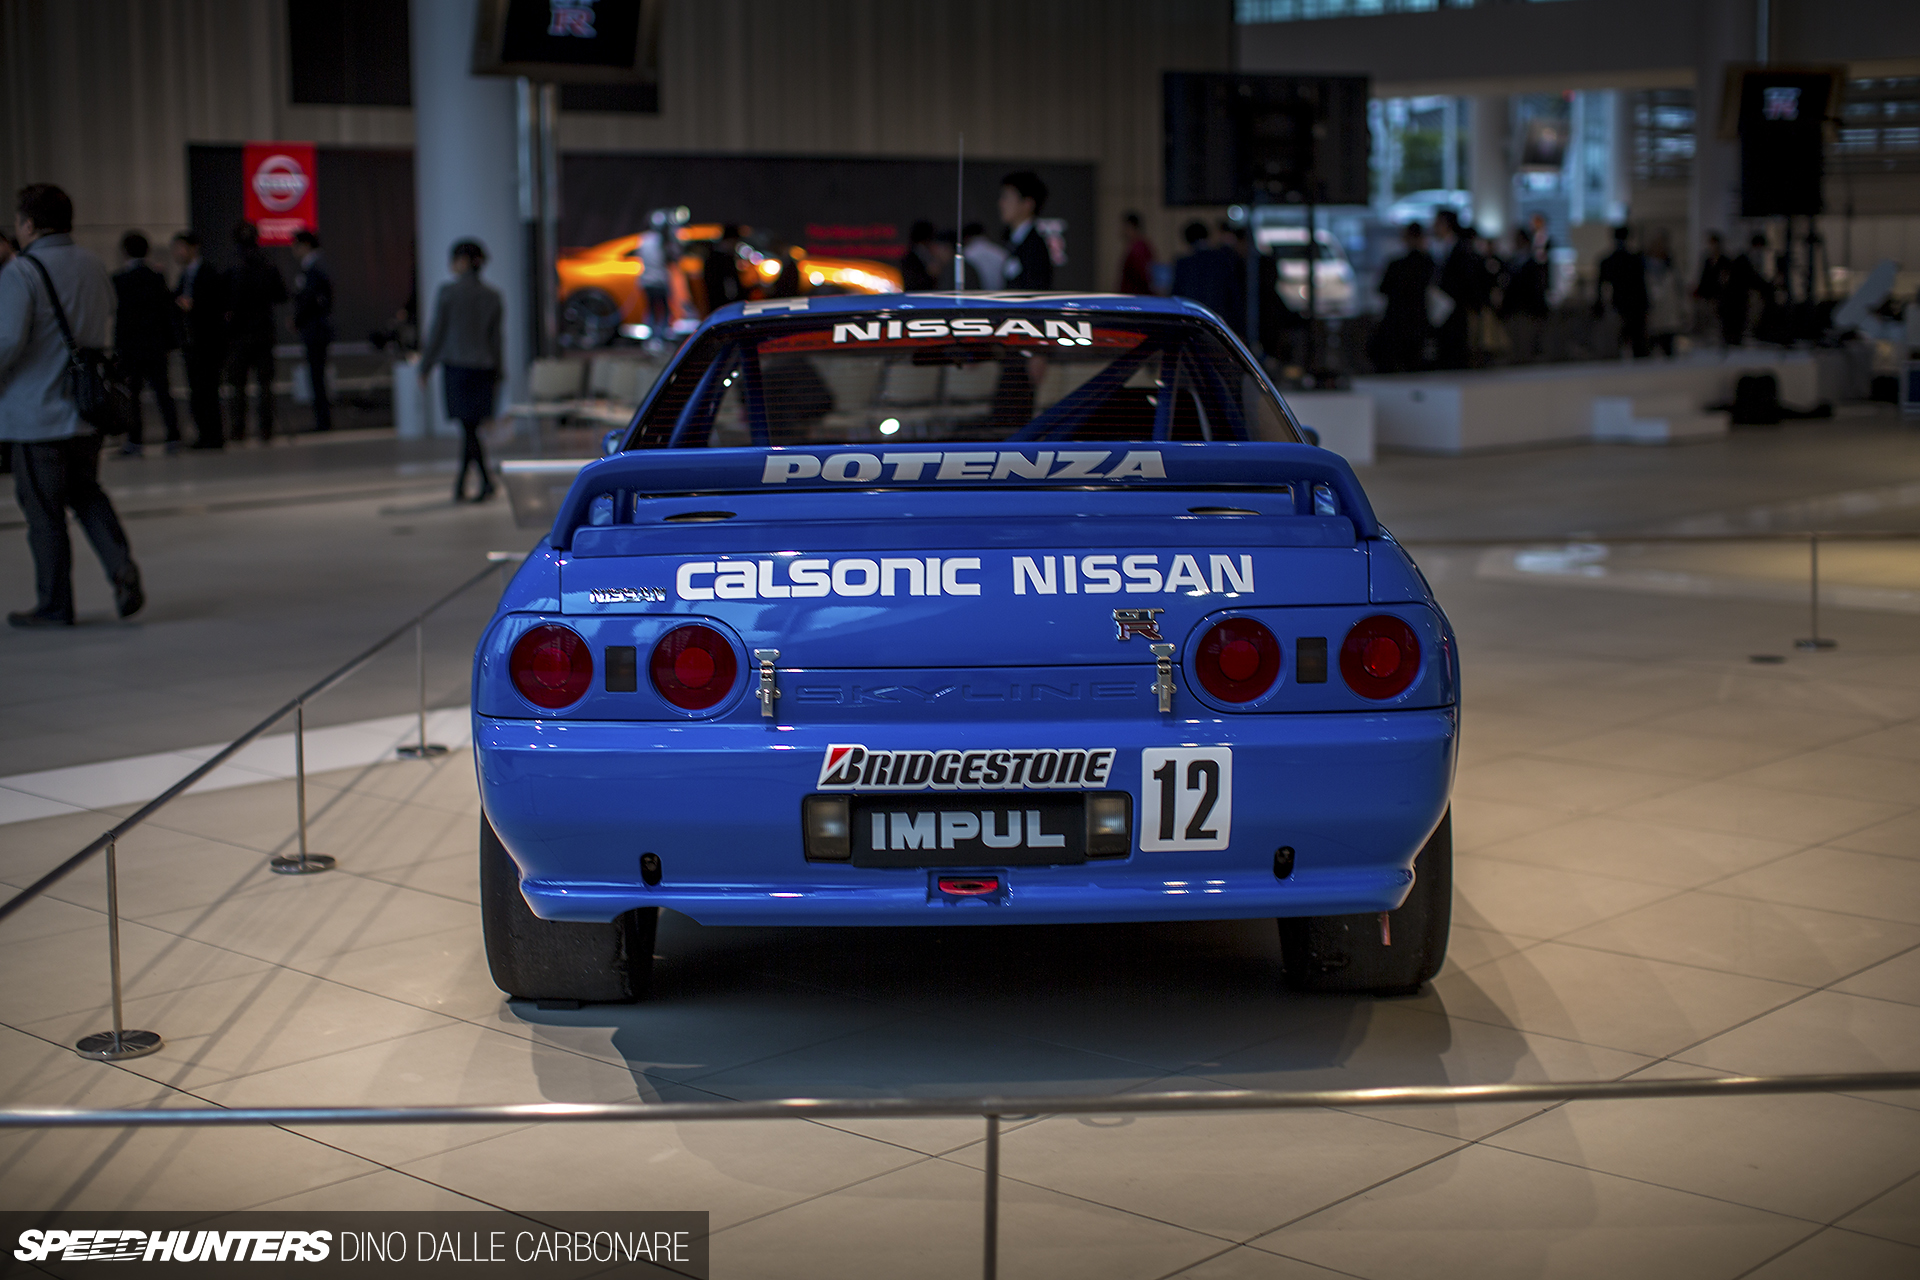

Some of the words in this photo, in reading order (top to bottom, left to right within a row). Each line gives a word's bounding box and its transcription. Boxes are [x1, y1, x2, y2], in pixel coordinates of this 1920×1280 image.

[832, 318, 1093, 343] NISSAN
[761, 450, 1167, 484] POTENZA
[589, 587, 666, 604] NISSAN
[676, 557, 981, 601] CALSONIC
[1012, 554, 1255, 595] NISSAN
[796, 682, 1138, 704] SKYLINE
[820, 745, 1113, 788] BRIDGESTONE
[1153, 758, 1221, 842] 12
[871, 810, 1066, 851] IMPUL
